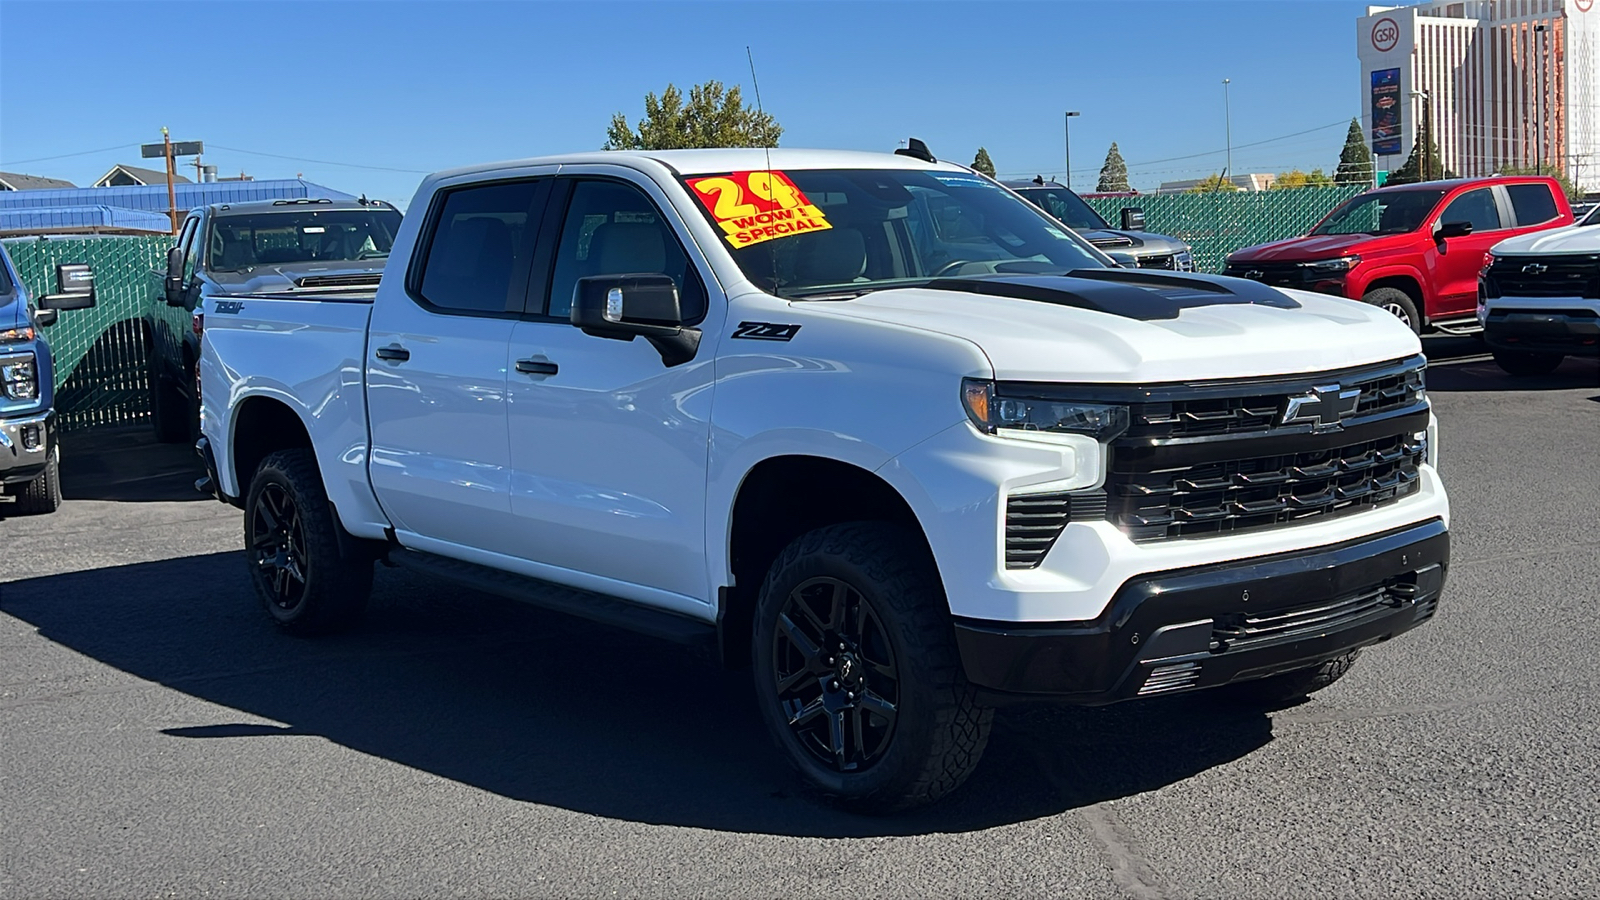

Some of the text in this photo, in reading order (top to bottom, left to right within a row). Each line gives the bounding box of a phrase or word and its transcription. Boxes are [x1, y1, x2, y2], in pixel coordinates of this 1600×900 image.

[1375, 28, 1395, 43] GSR
[695, 171, 801, 218] 24
[732, 209, 793, 229] WOW
[735, 219, 823, 243] SPECIAL
